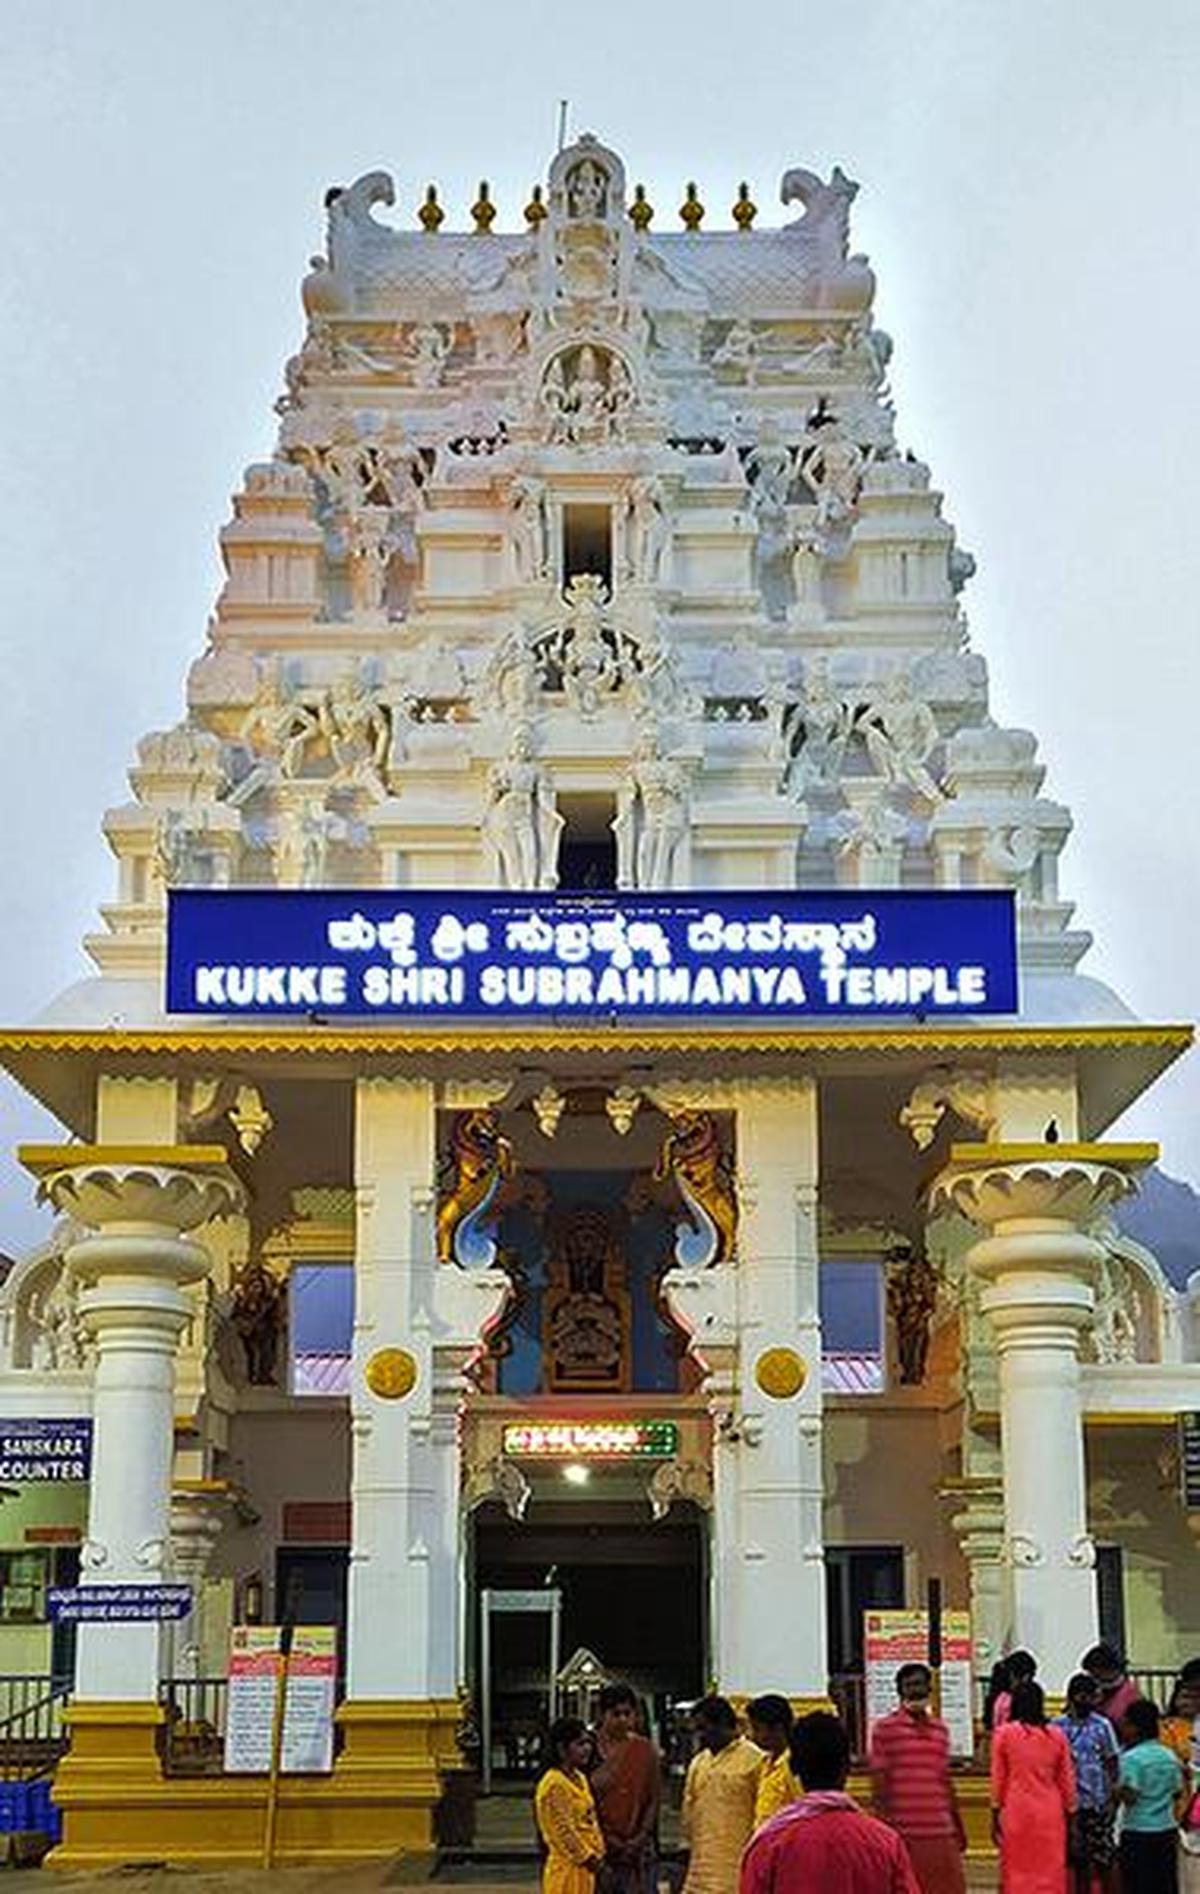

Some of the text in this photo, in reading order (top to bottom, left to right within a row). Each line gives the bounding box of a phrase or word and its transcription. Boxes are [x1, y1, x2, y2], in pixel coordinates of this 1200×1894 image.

[195, 965, 987, 1005] KUKKE SHRI SUBRAHMANYA TEMPLE
[0, 1461, 84, 1479] COUNTER
